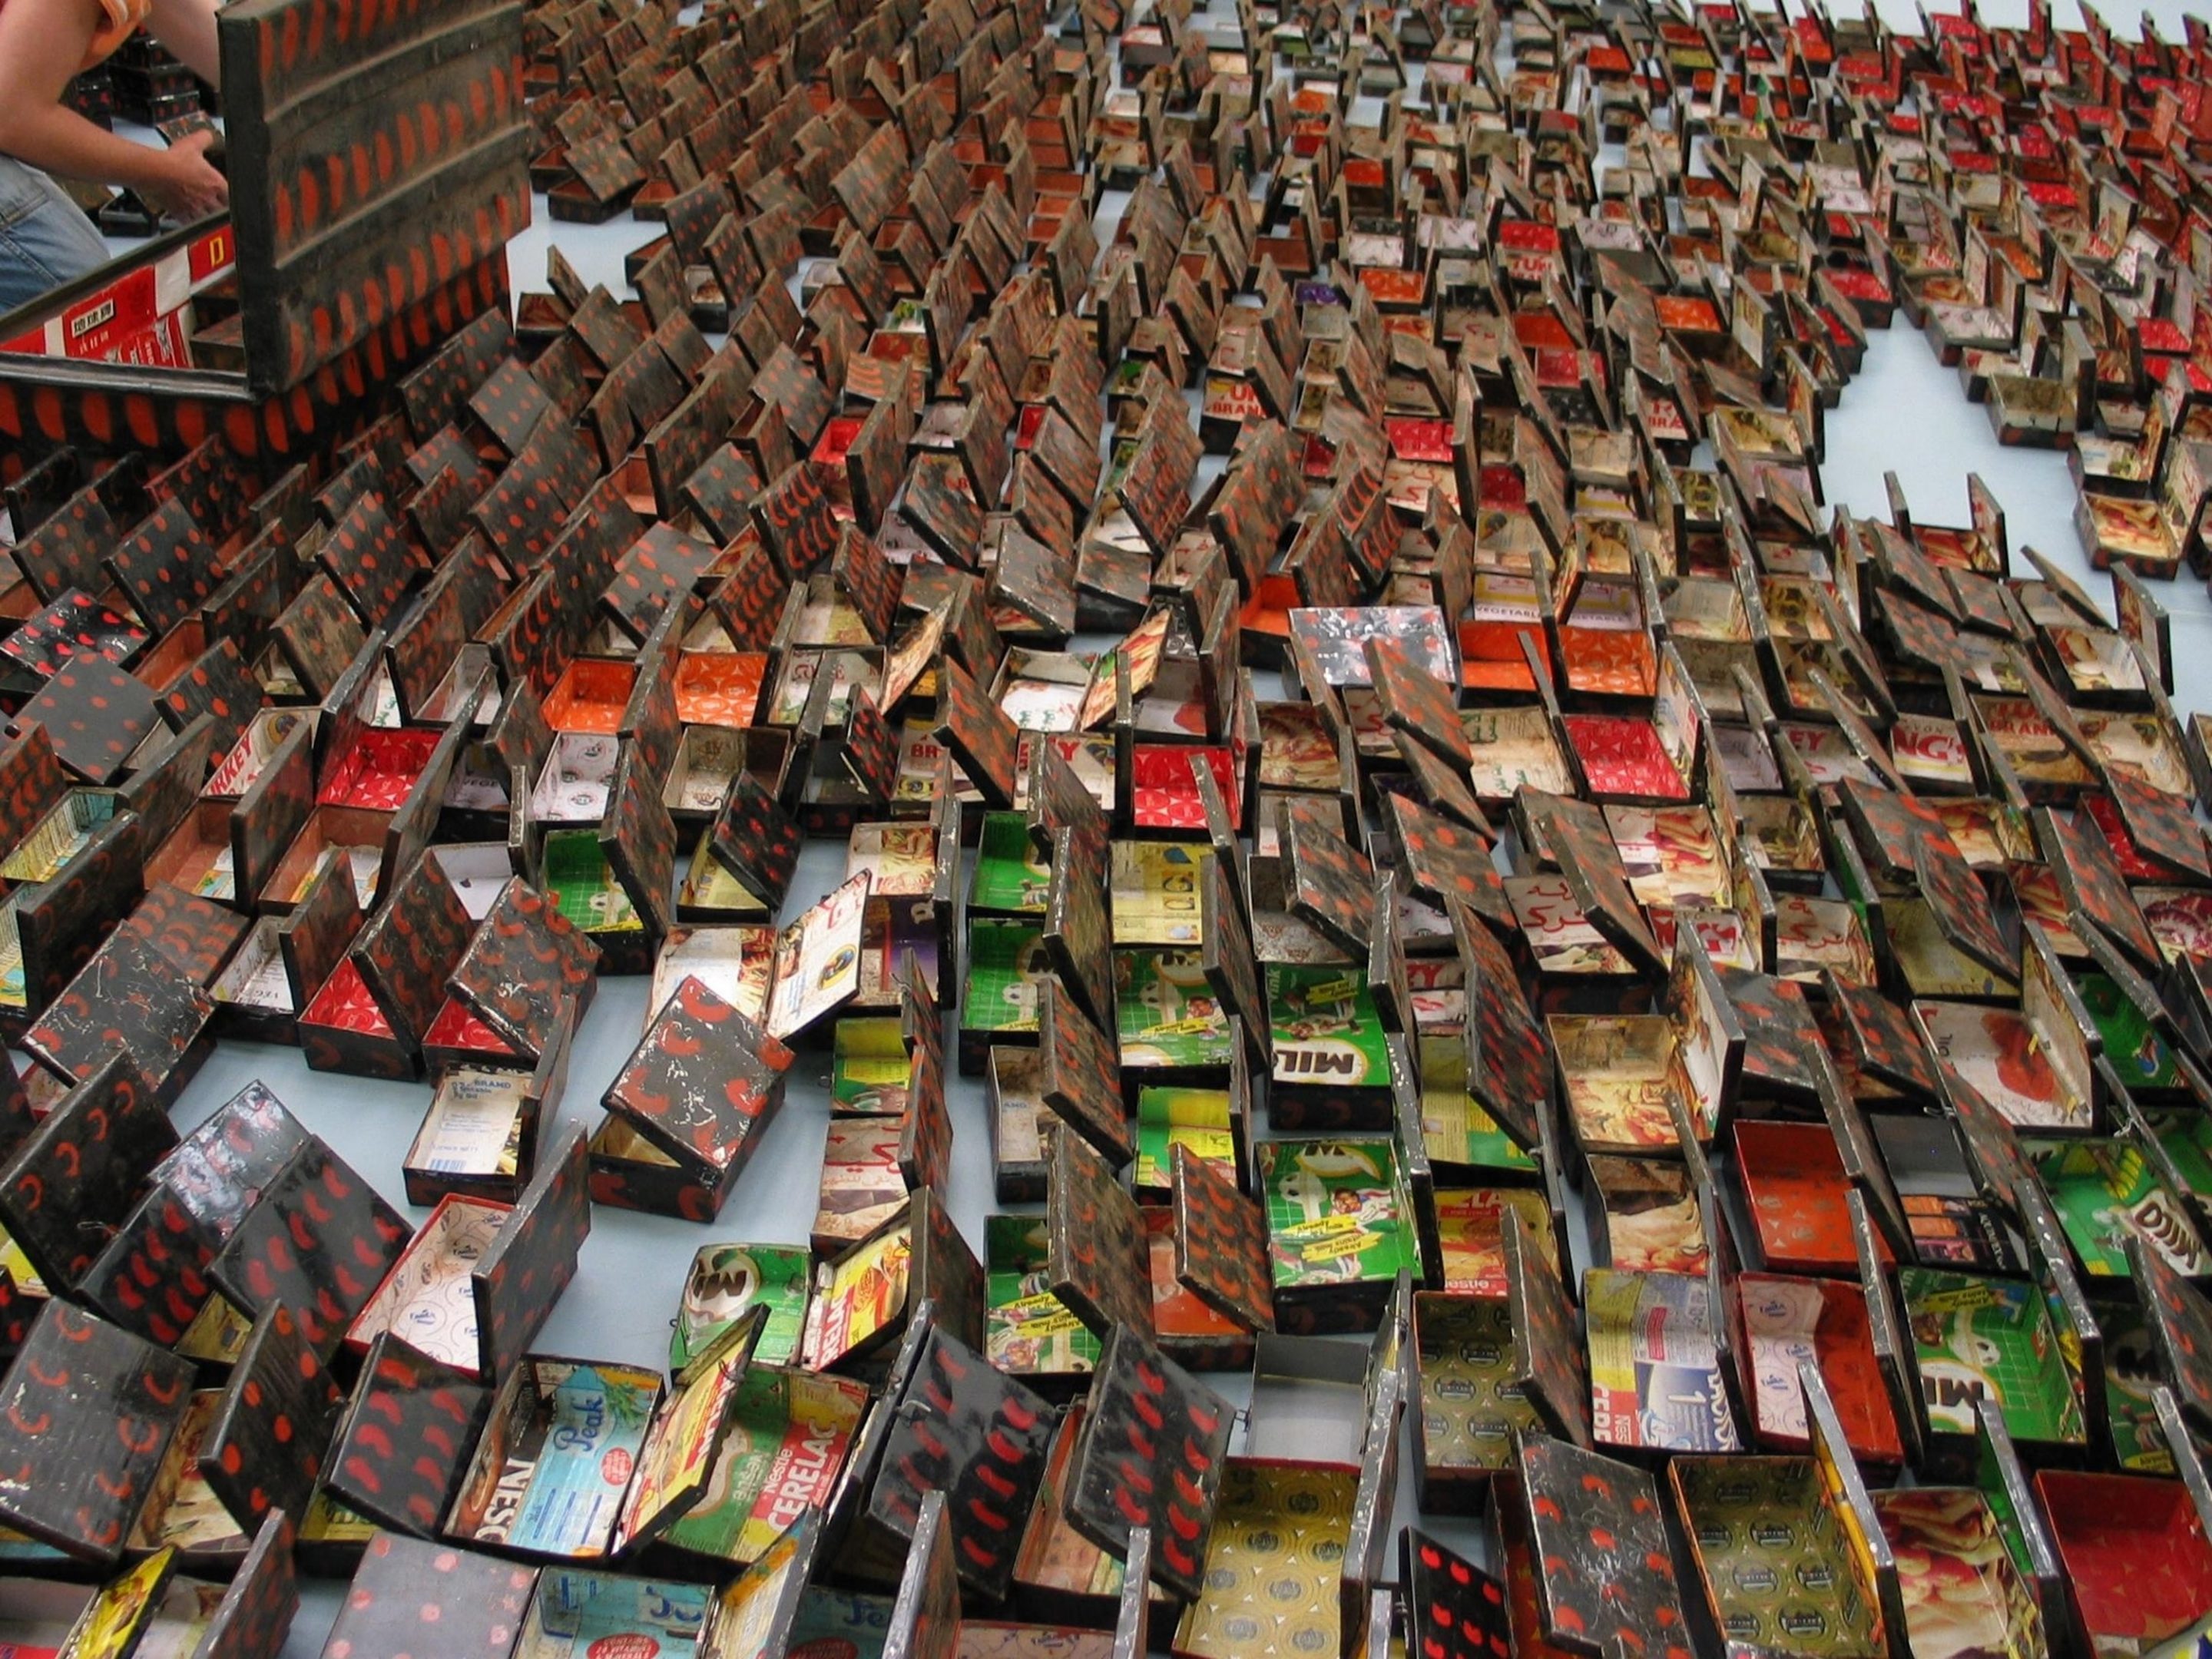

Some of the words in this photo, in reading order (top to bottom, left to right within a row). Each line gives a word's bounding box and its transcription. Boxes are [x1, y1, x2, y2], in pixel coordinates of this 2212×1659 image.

[1277, 1050, 1355, 1074] MIL
[553, 1396, 604, 1452] Peak
[767, 1418, 838, 1532] CERELAC
